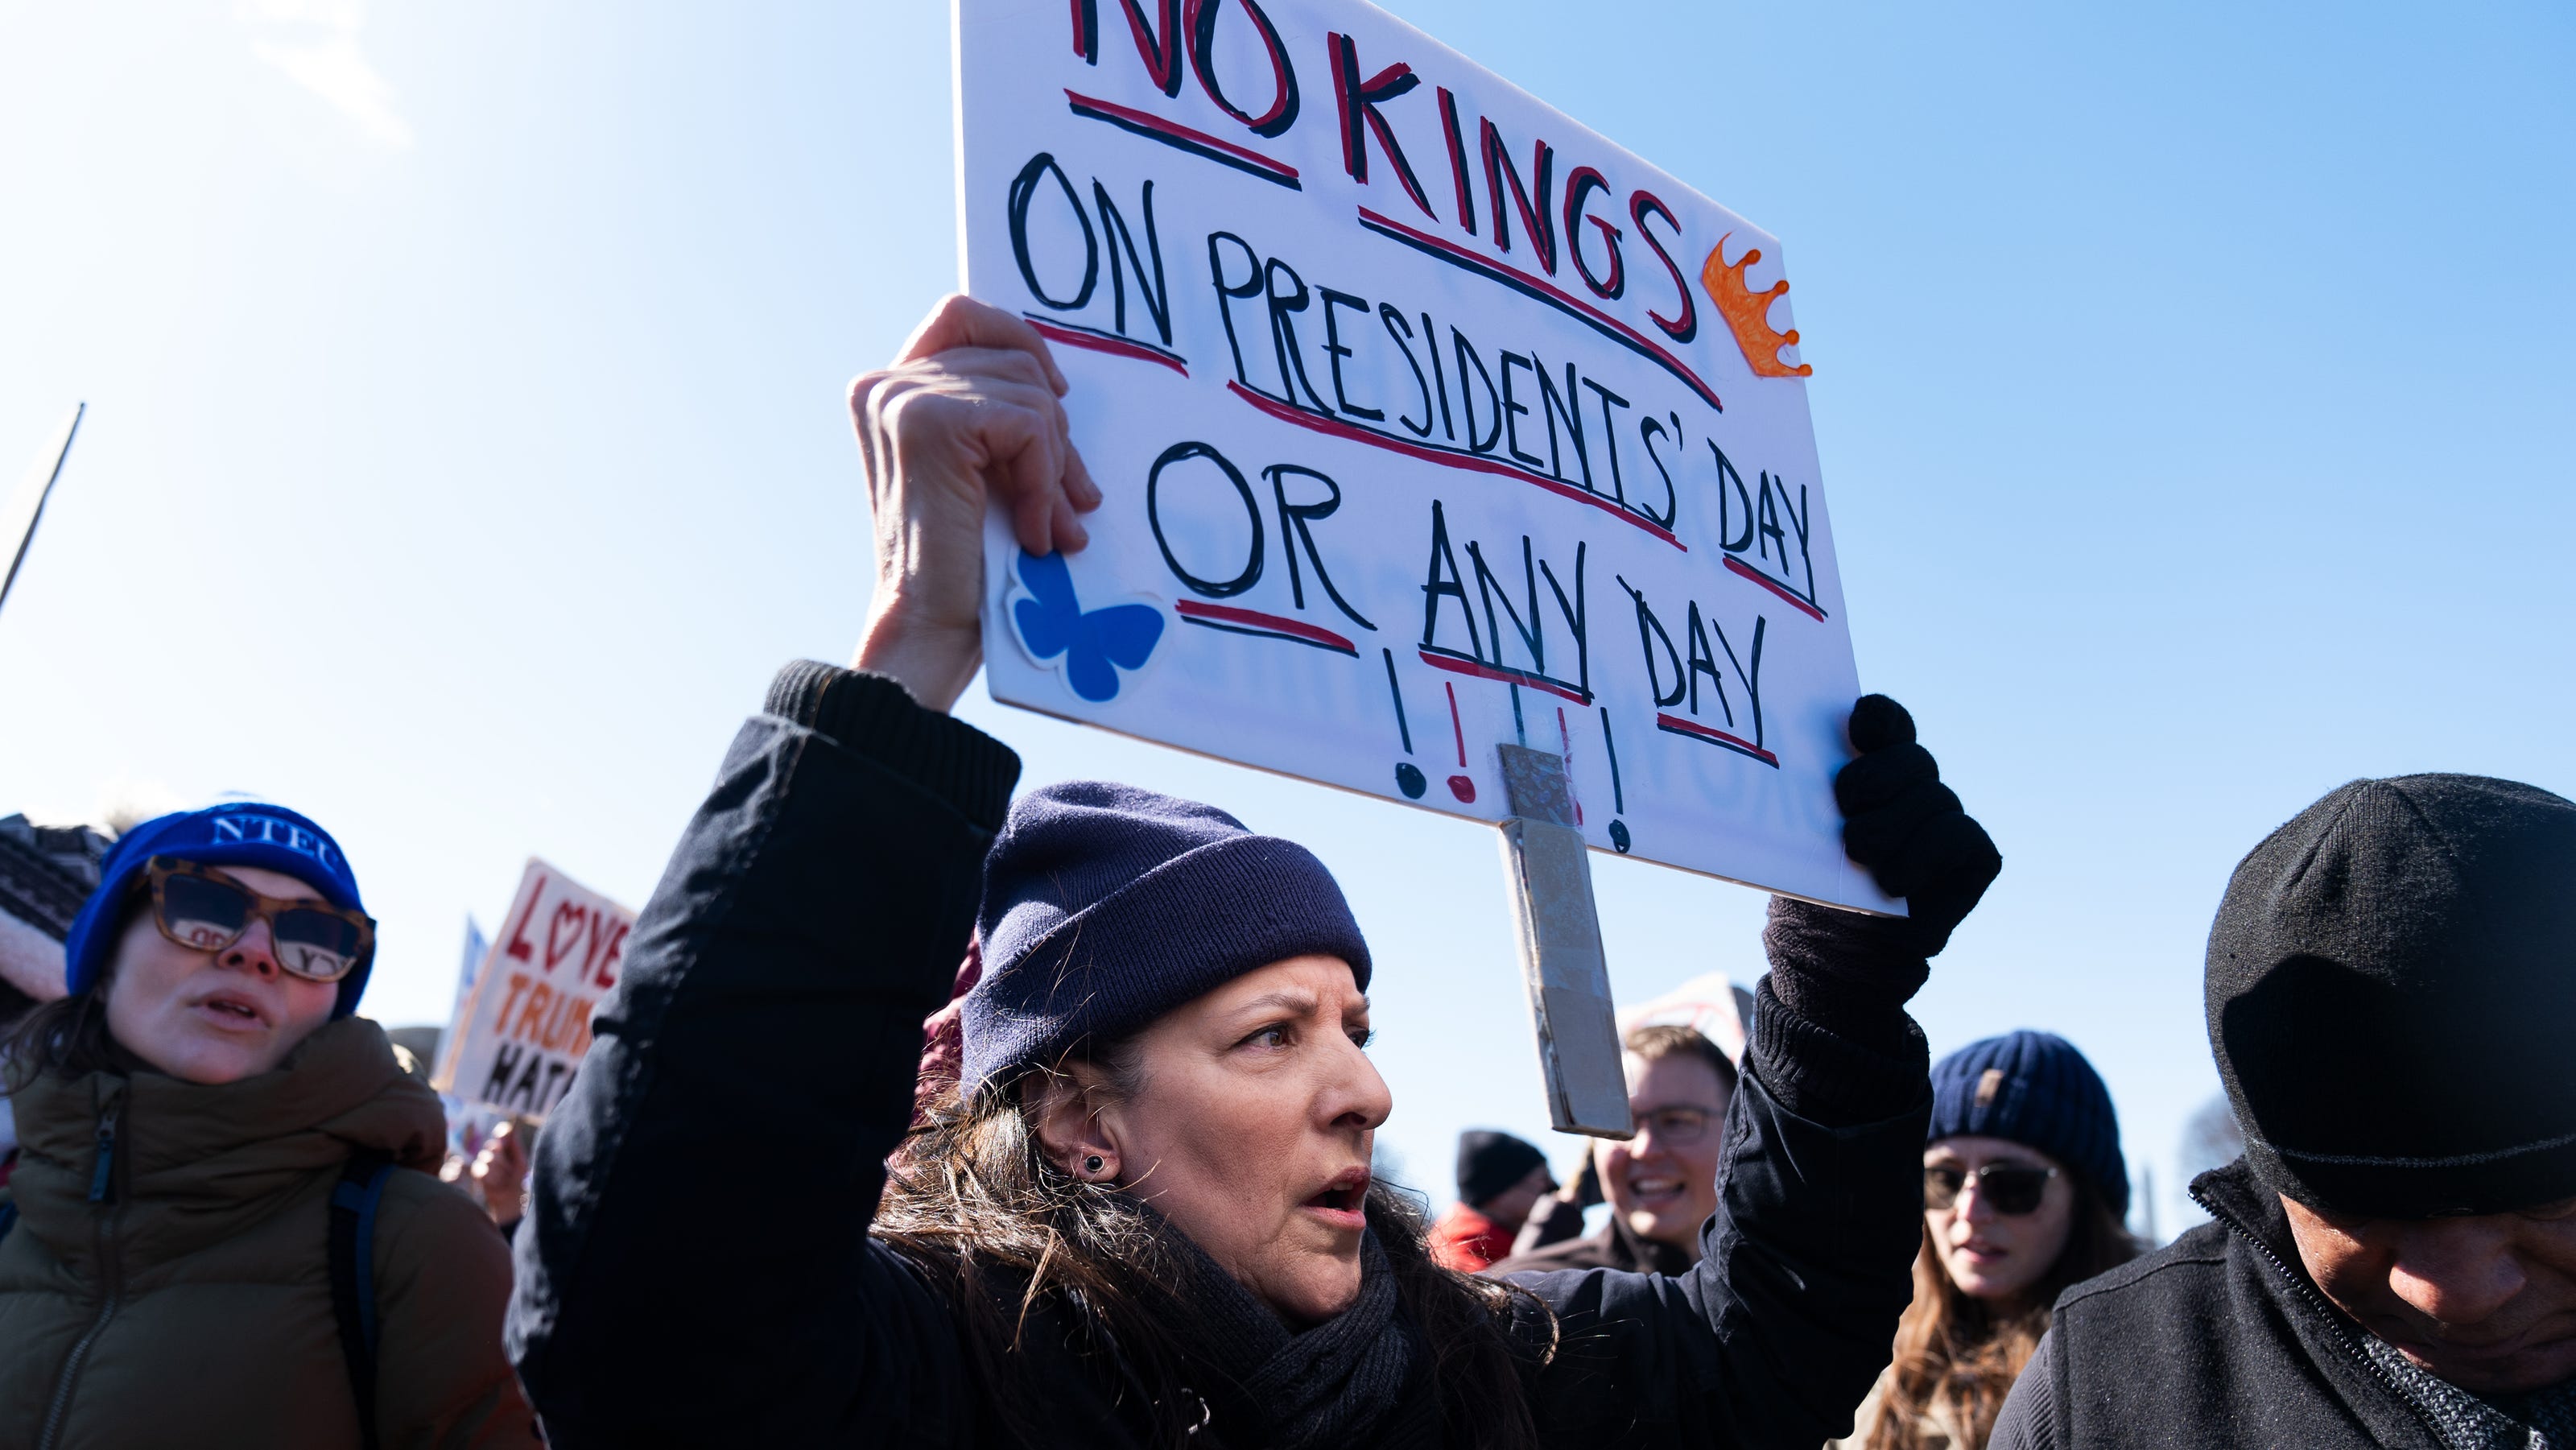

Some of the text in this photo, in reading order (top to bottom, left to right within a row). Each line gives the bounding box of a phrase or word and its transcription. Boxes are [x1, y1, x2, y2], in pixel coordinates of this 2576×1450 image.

[1070, 0, 1697, 344] NO KINGS
[1008, 152, 1816, 605] ON PRESIDENTS' DAY
[1147, 441, 1765, 750] OR ANY DAY
[481, 1044, 578, 1114] HAT
[493, 973, 595, 1058] TRUM
